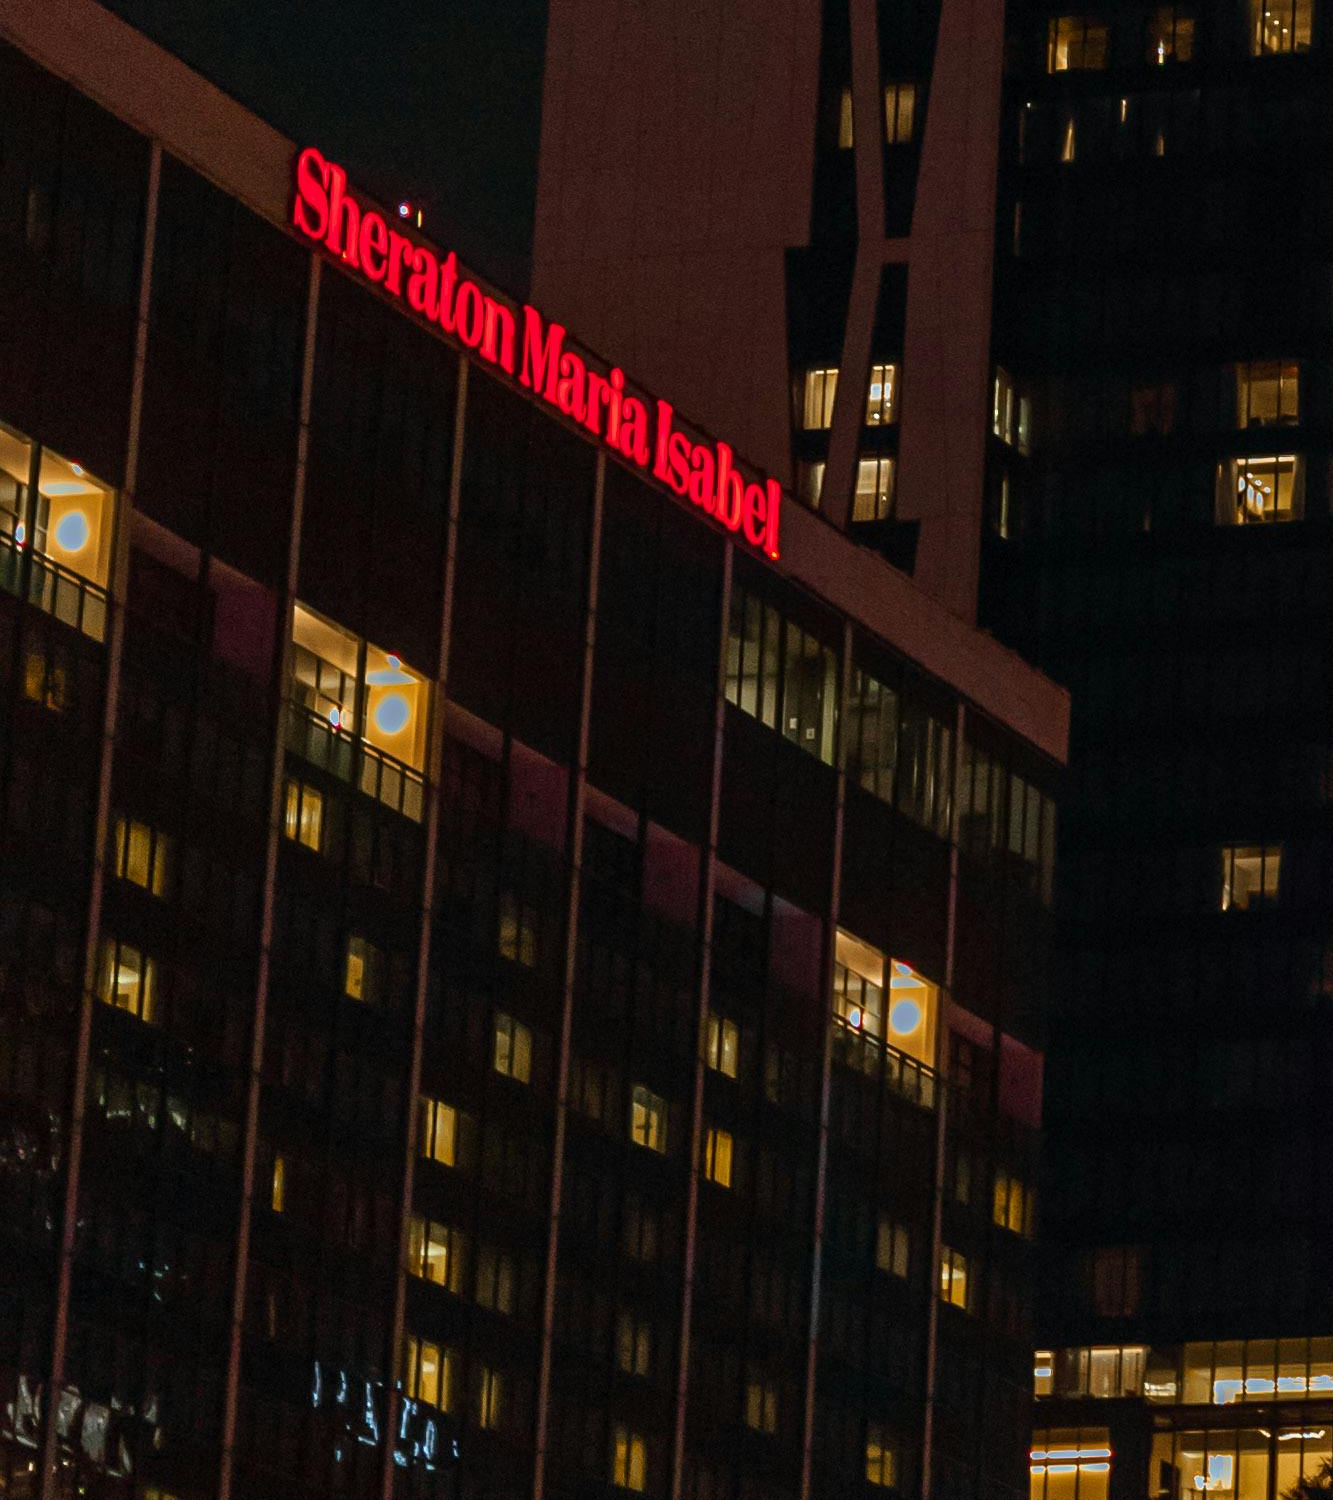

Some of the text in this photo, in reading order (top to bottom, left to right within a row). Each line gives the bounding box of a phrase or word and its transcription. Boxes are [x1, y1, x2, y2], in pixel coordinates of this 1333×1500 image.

[293, 147, 782, 561] Sheraton Maria Isabel
